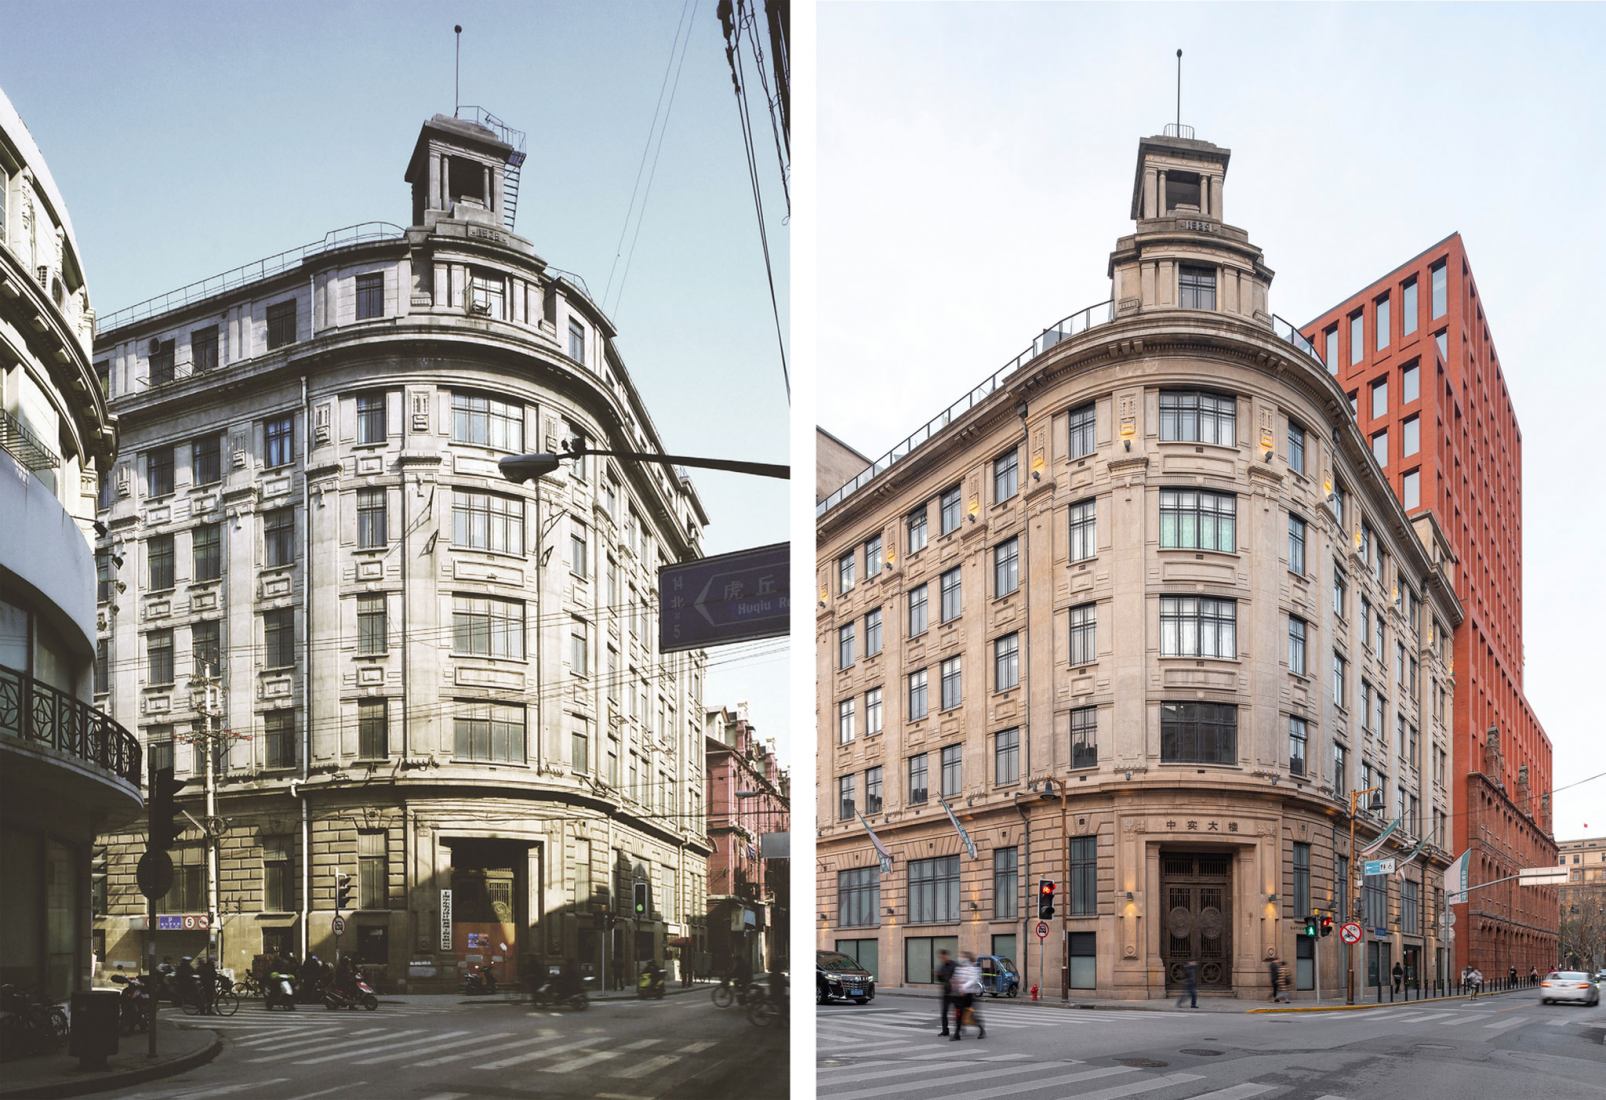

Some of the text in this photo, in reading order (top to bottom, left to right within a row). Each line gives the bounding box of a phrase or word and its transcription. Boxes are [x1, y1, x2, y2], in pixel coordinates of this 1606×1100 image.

[724, 574, 776, 600] 虎丘
[738, 597, 790, 615] Huqiu R
[1166, 819, 1239, 832] 中实大楼
[187, 918, 193, 927] 5
